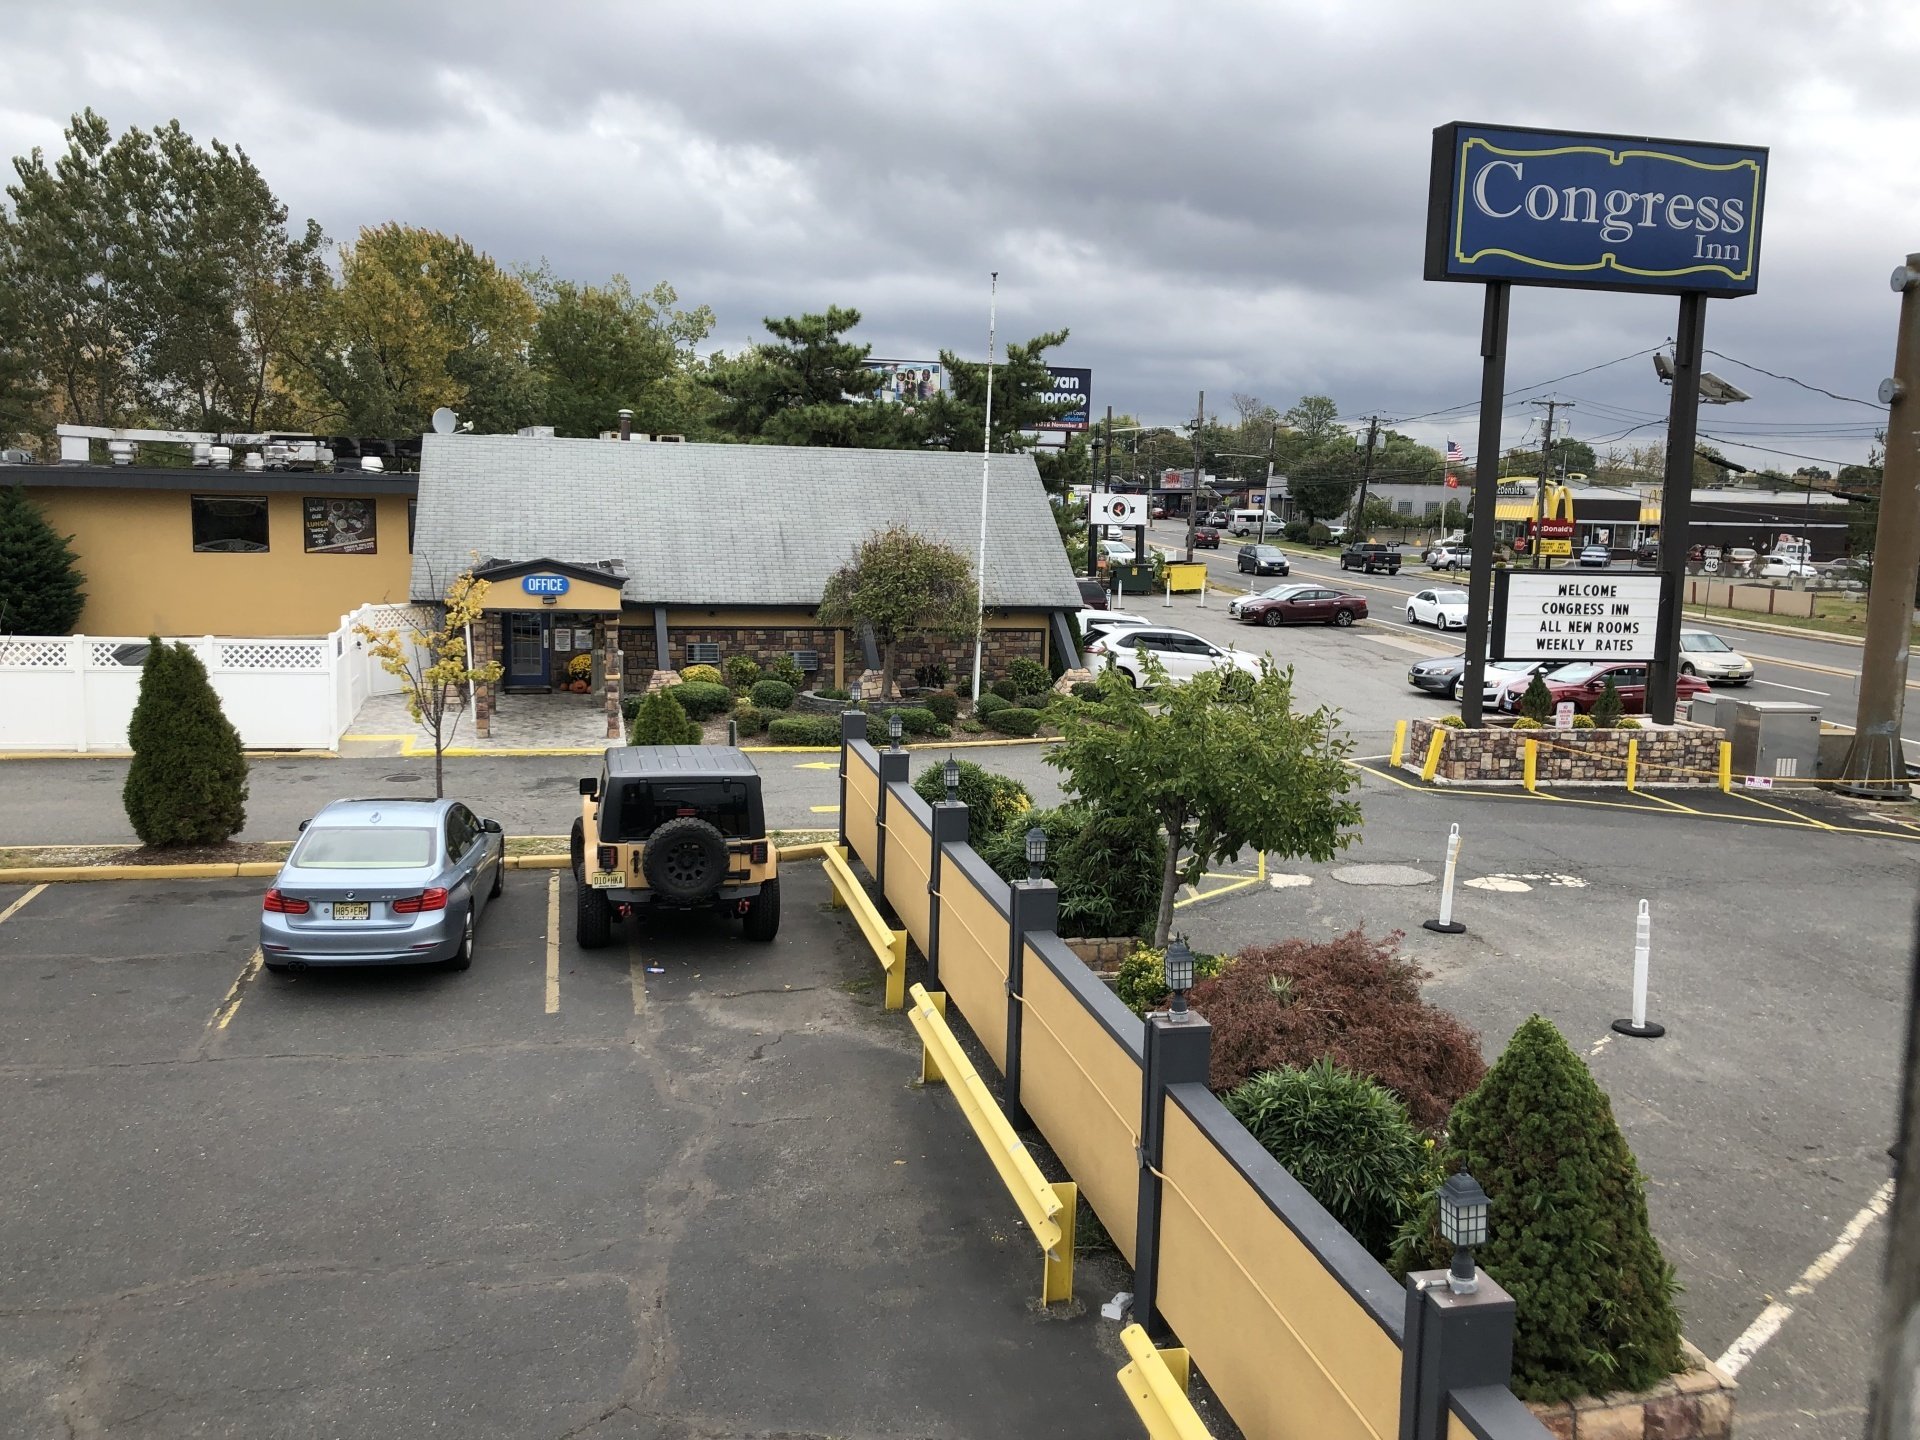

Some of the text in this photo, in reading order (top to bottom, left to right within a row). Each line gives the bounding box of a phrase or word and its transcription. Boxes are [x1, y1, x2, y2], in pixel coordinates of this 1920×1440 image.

[1472, 160, 1745, 243] Congress
[1693, 234, 1741, 261] Inn
[1706, 560, 1717, 569] 46
[528, 578, 563, 591] OFFICE
[1558, 584, 1618, 597] WELCOME
[1541, 602, 1630, 615] CONGRESS INN
[1539, 620, 1640, 633] ALL NEW ROOMS
[1536, 638, 1634, 651] WEEKLY RATES
